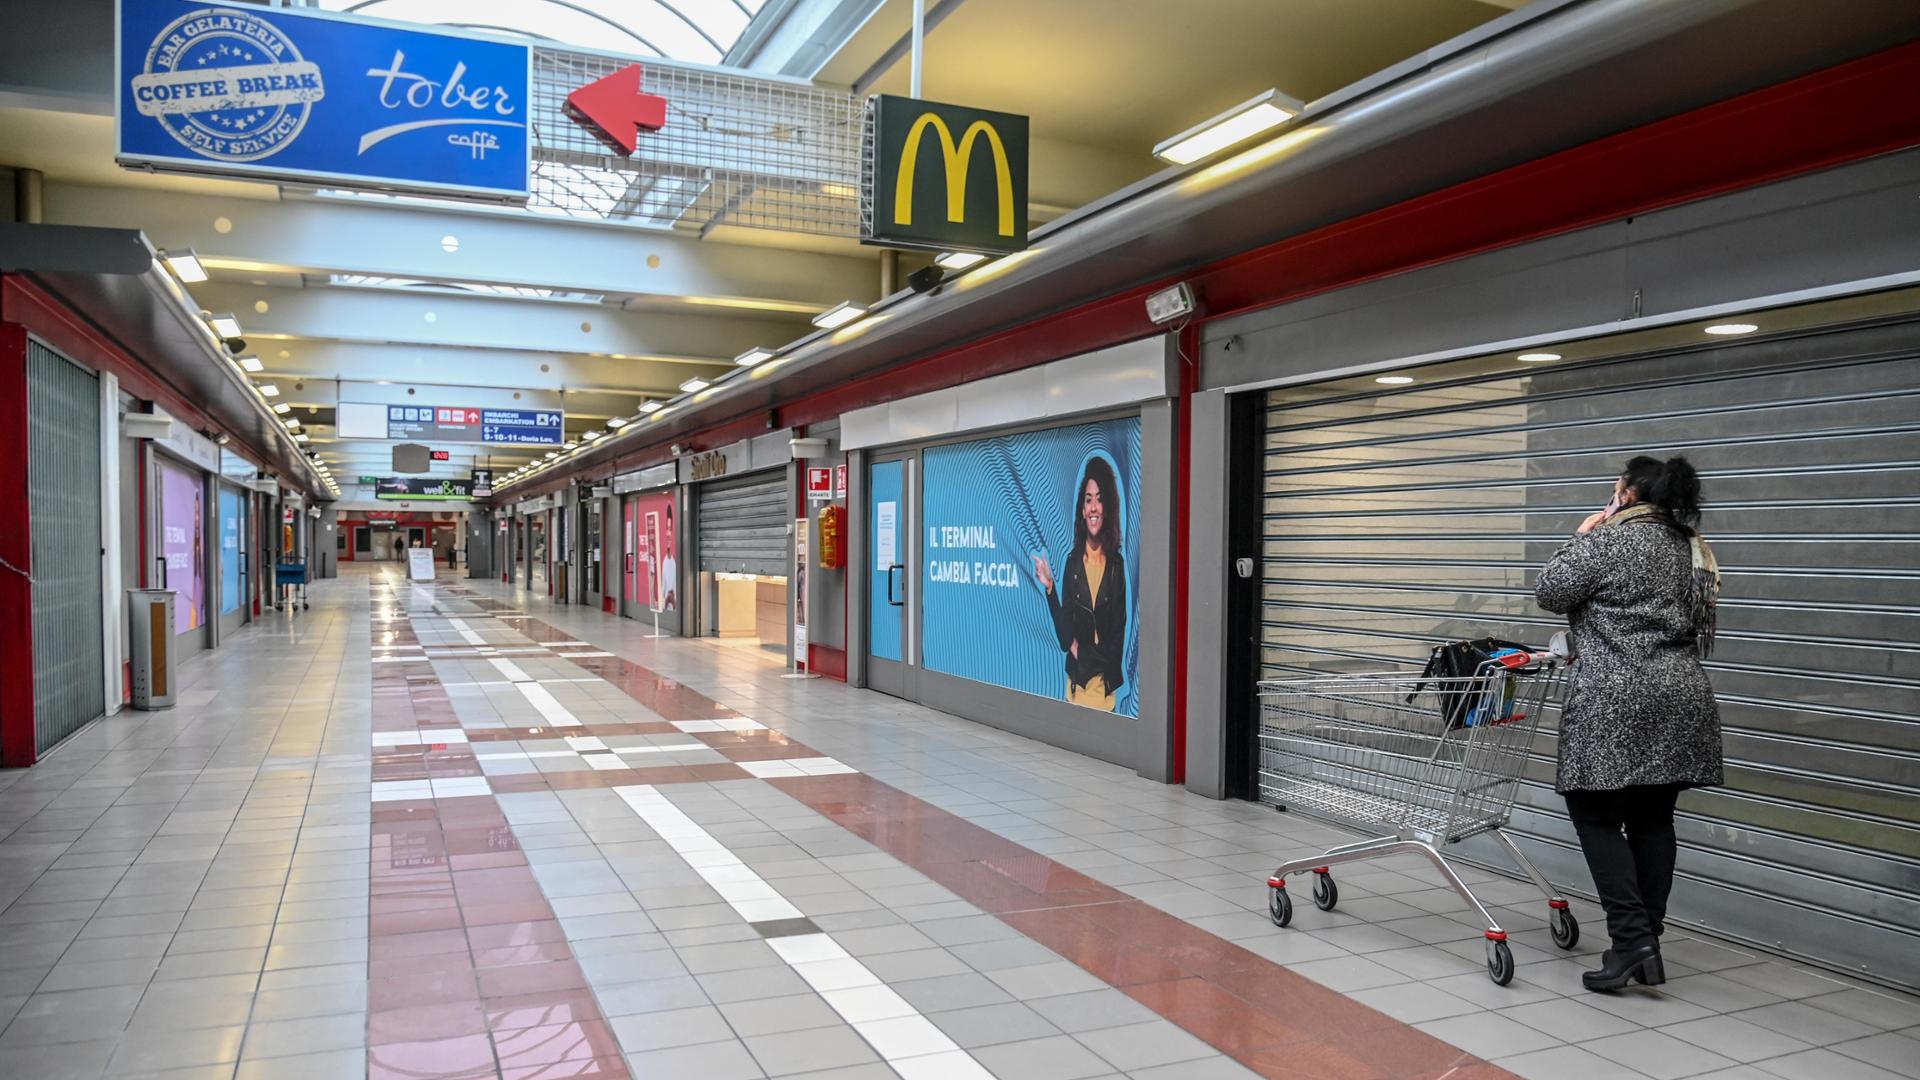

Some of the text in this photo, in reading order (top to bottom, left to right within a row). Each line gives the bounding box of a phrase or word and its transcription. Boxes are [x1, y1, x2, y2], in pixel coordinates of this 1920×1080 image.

[157, 16, 286, 69] BAR GELATERIA
[137, 73, 319, 102] COFFEE BREAK
[180, 113, 298, 154] SELF SERVICE
[484, 411, 519, 419] IMBARCHI
[484, 418, 535, 426] EMBARKATION
[930, 526, 996, 549] IL TERMINAL
[930, 560, 1020, 588] CAMBIA FACCIA
